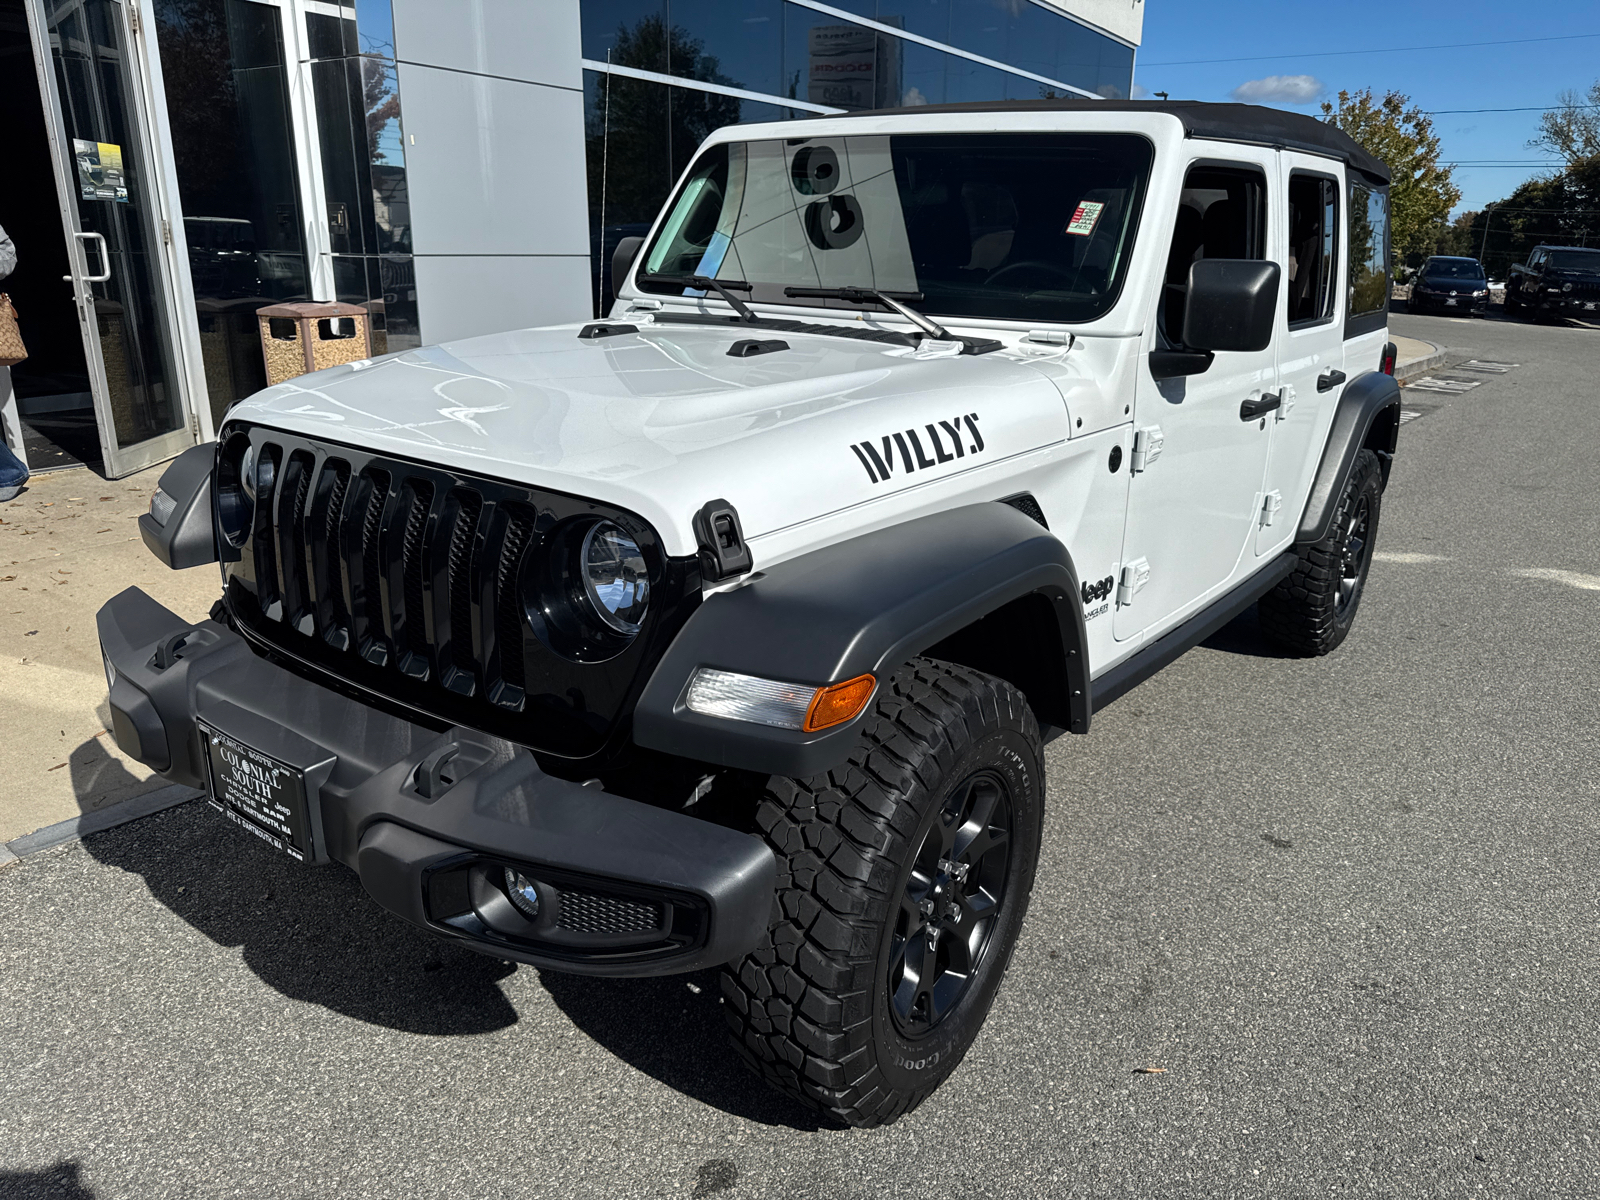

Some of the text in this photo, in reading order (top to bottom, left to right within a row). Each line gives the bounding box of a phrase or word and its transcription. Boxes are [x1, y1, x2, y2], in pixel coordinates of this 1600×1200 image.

[849, 412, 985, 484] WILLYS
[1080, 575, 1114, 605] Jeep
[220, 746, 282, 790] COLONIAL
[231, 766, 273, 800] SOUTH
[220, 773, 292, 817] CHRYSLER Jeep
[227, 785, 257, 808] DODGE
[262, 806, 285, 822] RAM
[242, 803, 281, 831] DARTMOUTH,
[281, 824, 292, 836] MA
[273, 839, 283, 850] MA
